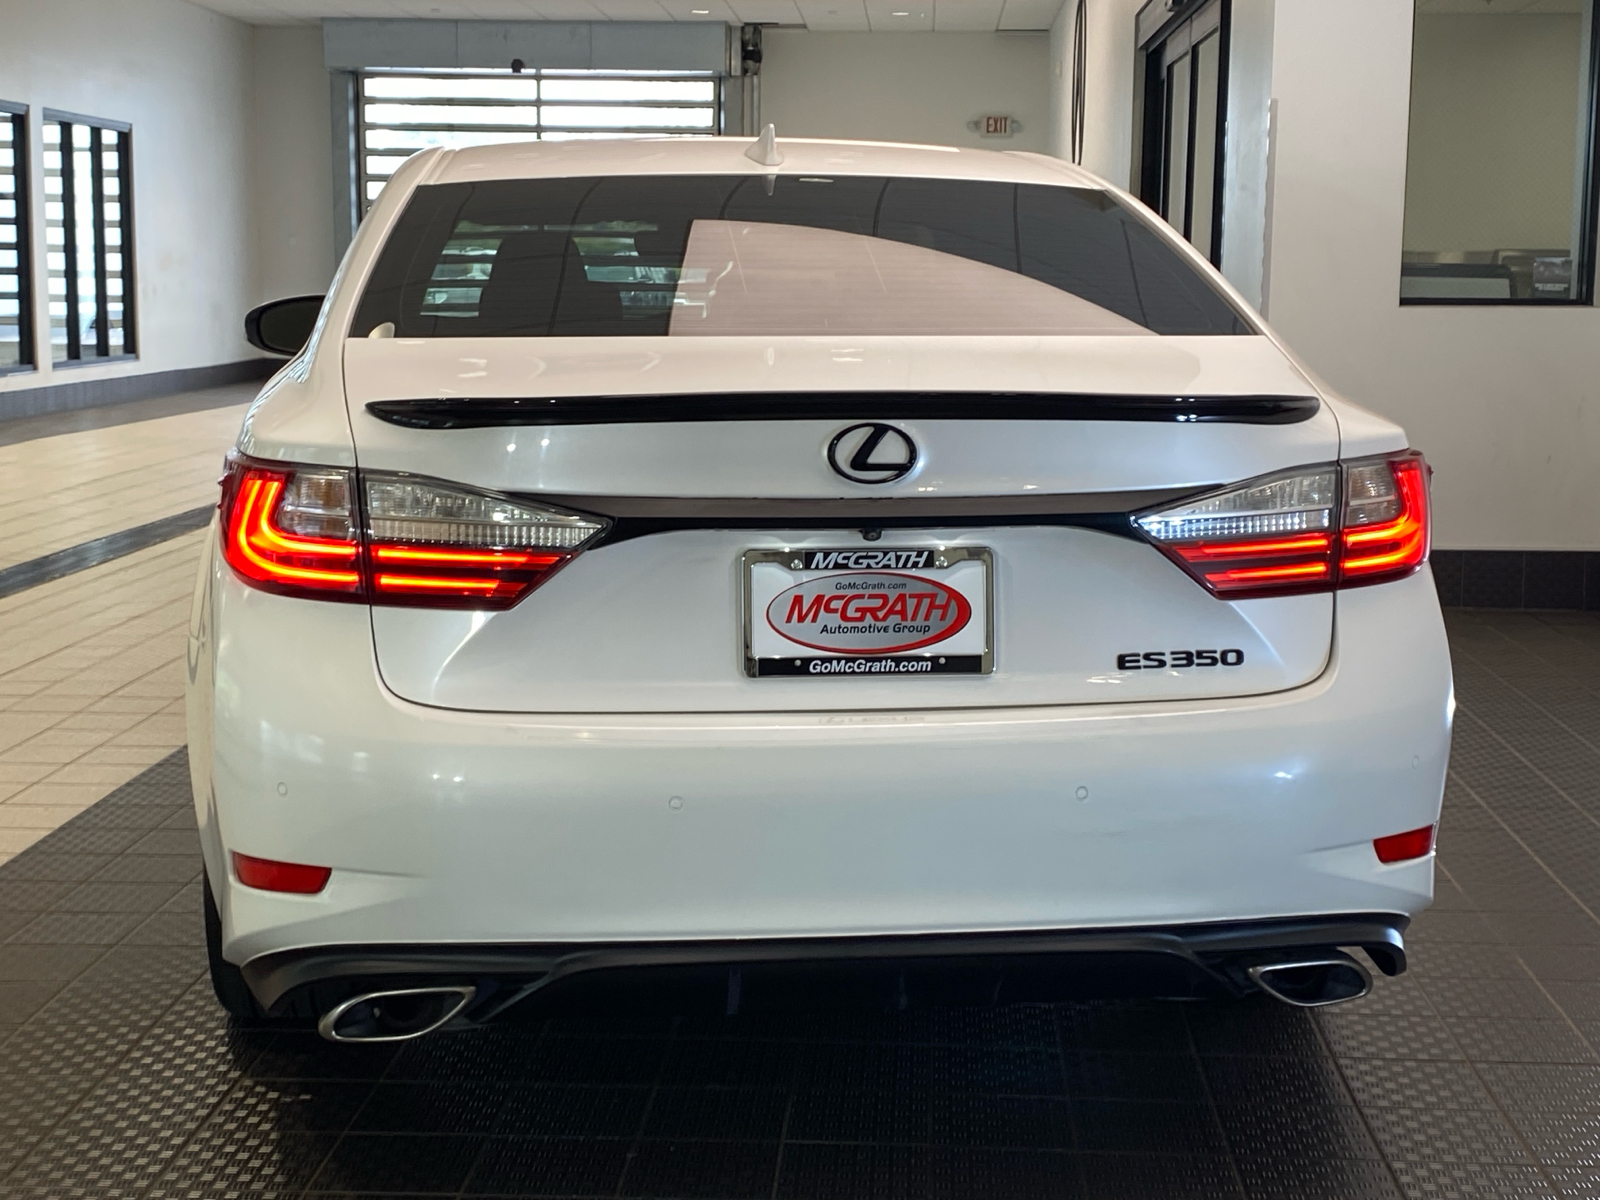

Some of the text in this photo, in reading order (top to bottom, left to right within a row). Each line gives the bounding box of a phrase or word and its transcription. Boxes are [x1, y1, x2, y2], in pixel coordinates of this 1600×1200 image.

[986, 116, 1009, 134] EXIT
[834, 581, 907, 591] GoMcGrath.com
[820, 623, 931, 635] Automotive Group
[809, 658, 932, 673] GoMcGrath.com
